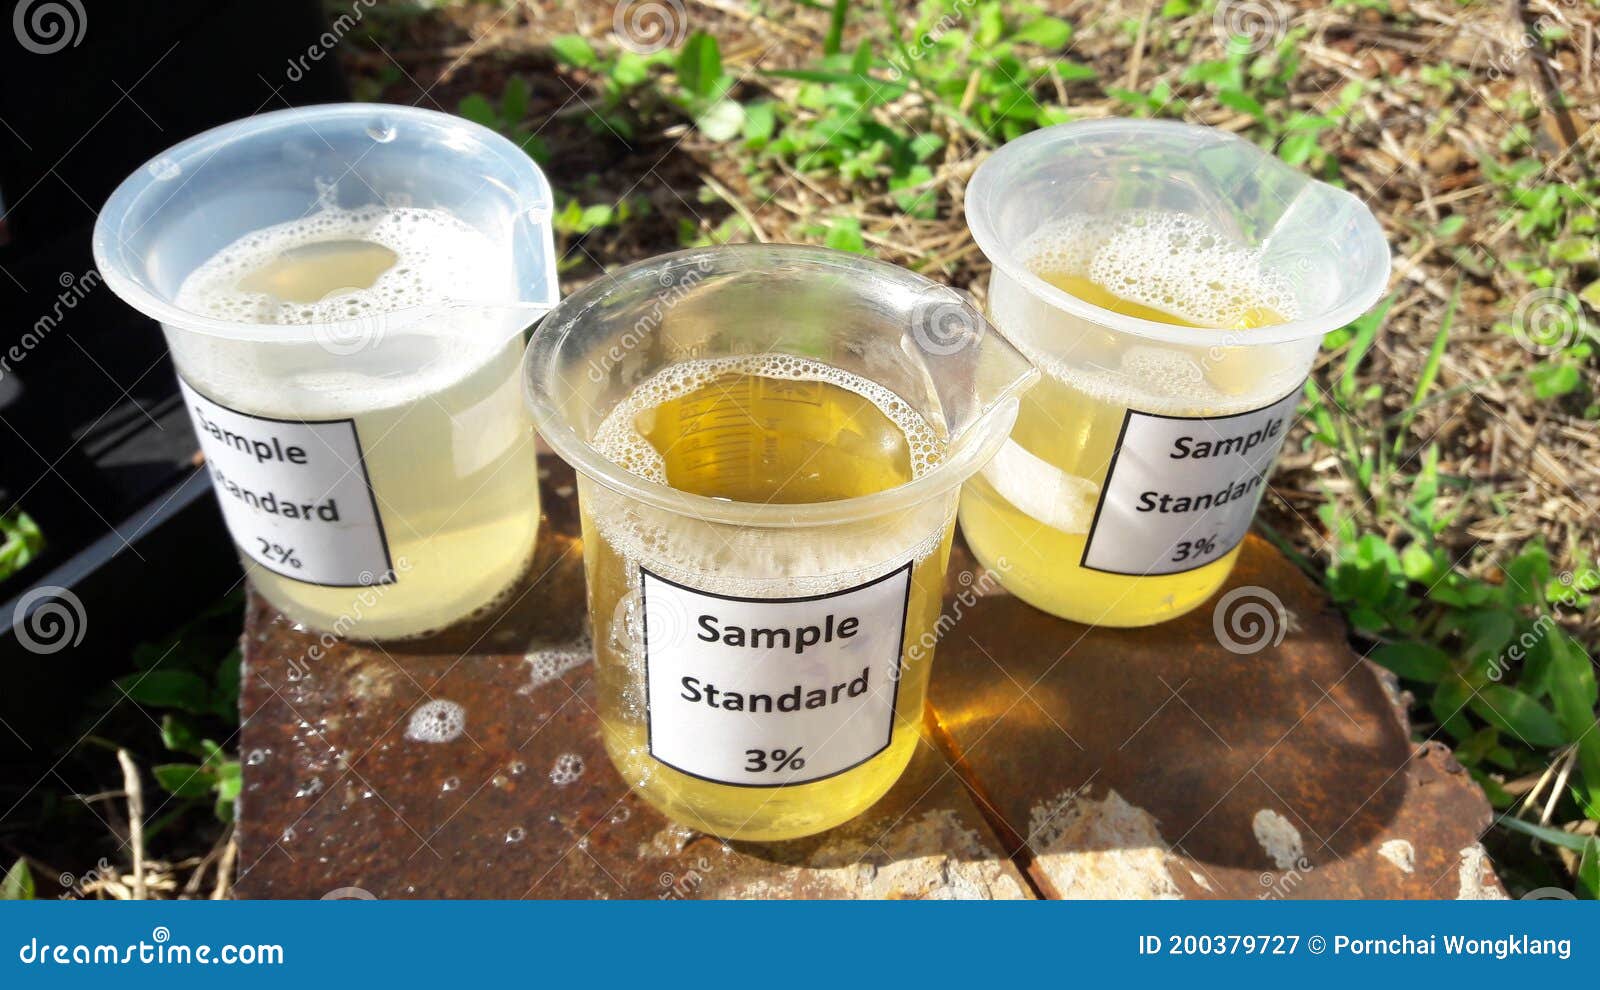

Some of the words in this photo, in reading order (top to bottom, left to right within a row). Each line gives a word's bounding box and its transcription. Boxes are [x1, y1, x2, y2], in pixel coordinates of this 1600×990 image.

[195, 406, 308, 464] Sample
[1170, 417, 1283, 459] Sample
[209, 458, 339, 522] tandard
[256, 536, 304, 569] 2%
[1171, 533, 1218, 563] 3%
[697, 614, 860, 654] Sample
[681, 667, 870, 713] Standard
[744, 747, 806, 773] 3%
